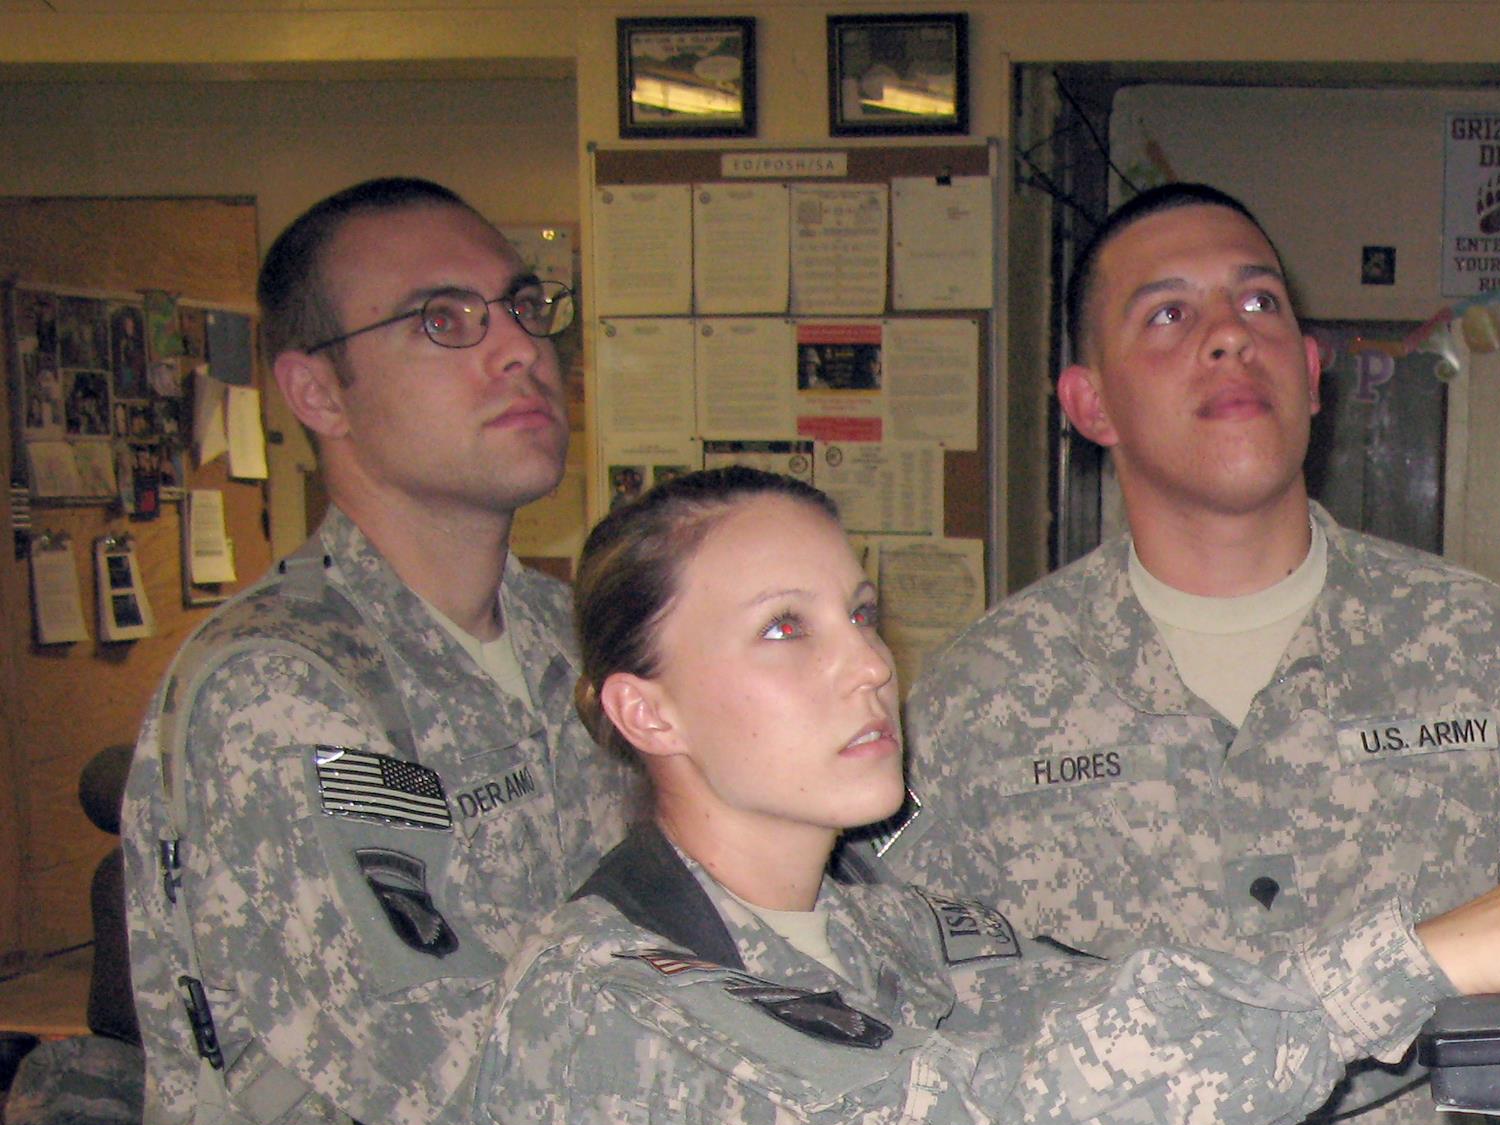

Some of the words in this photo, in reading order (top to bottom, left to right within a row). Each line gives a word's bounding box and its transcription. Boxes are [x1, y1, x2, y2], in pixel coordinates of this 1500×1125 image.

[1454, 257, 1500, 273] YOUR
[1360, 727, 1410, 754] U.S.
[1418, 719, 1488, 748] ARMY
[1033, 751, 1121, 785] FLORES
[456, 766, 536, 819] DERAMO
